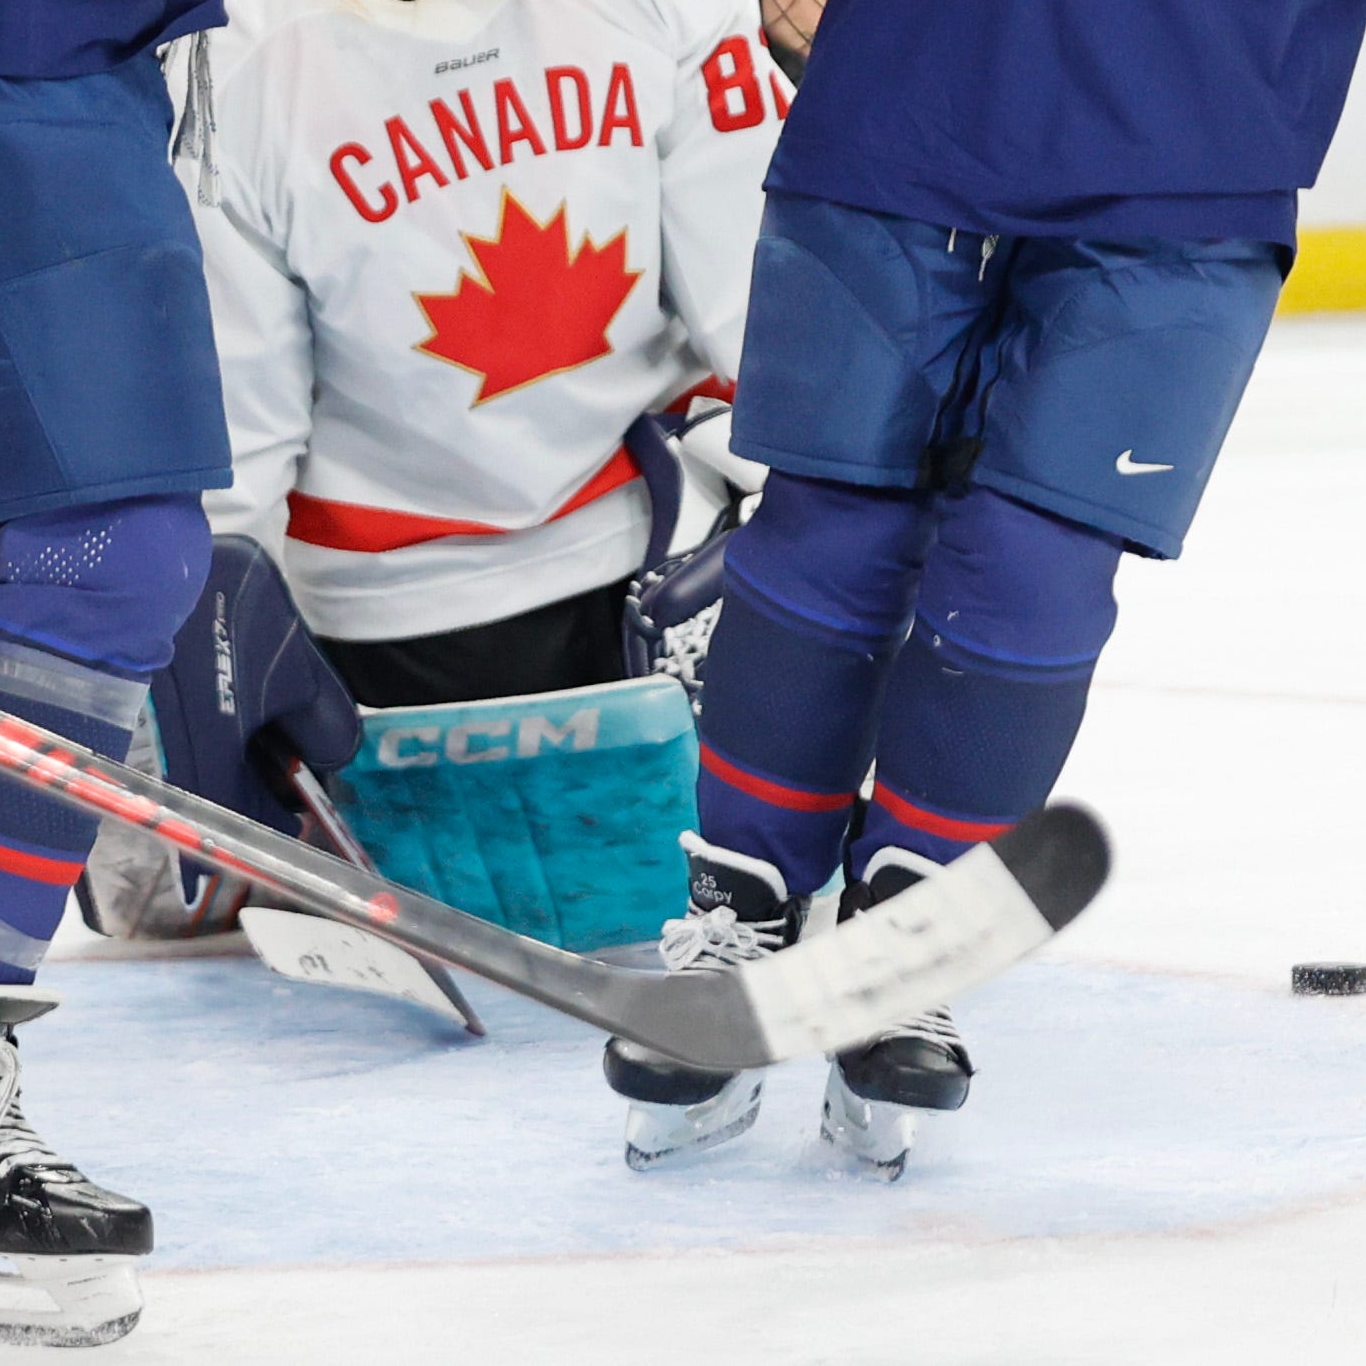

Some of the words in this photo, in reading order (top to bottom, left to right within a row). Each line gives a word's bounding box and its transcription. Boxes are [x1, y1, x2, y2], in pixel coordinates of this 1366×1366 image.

[328, 60, 644, 224] CANADA
[377, 707, 601, 770] CCM
[700, 872, 717, 889] 25
